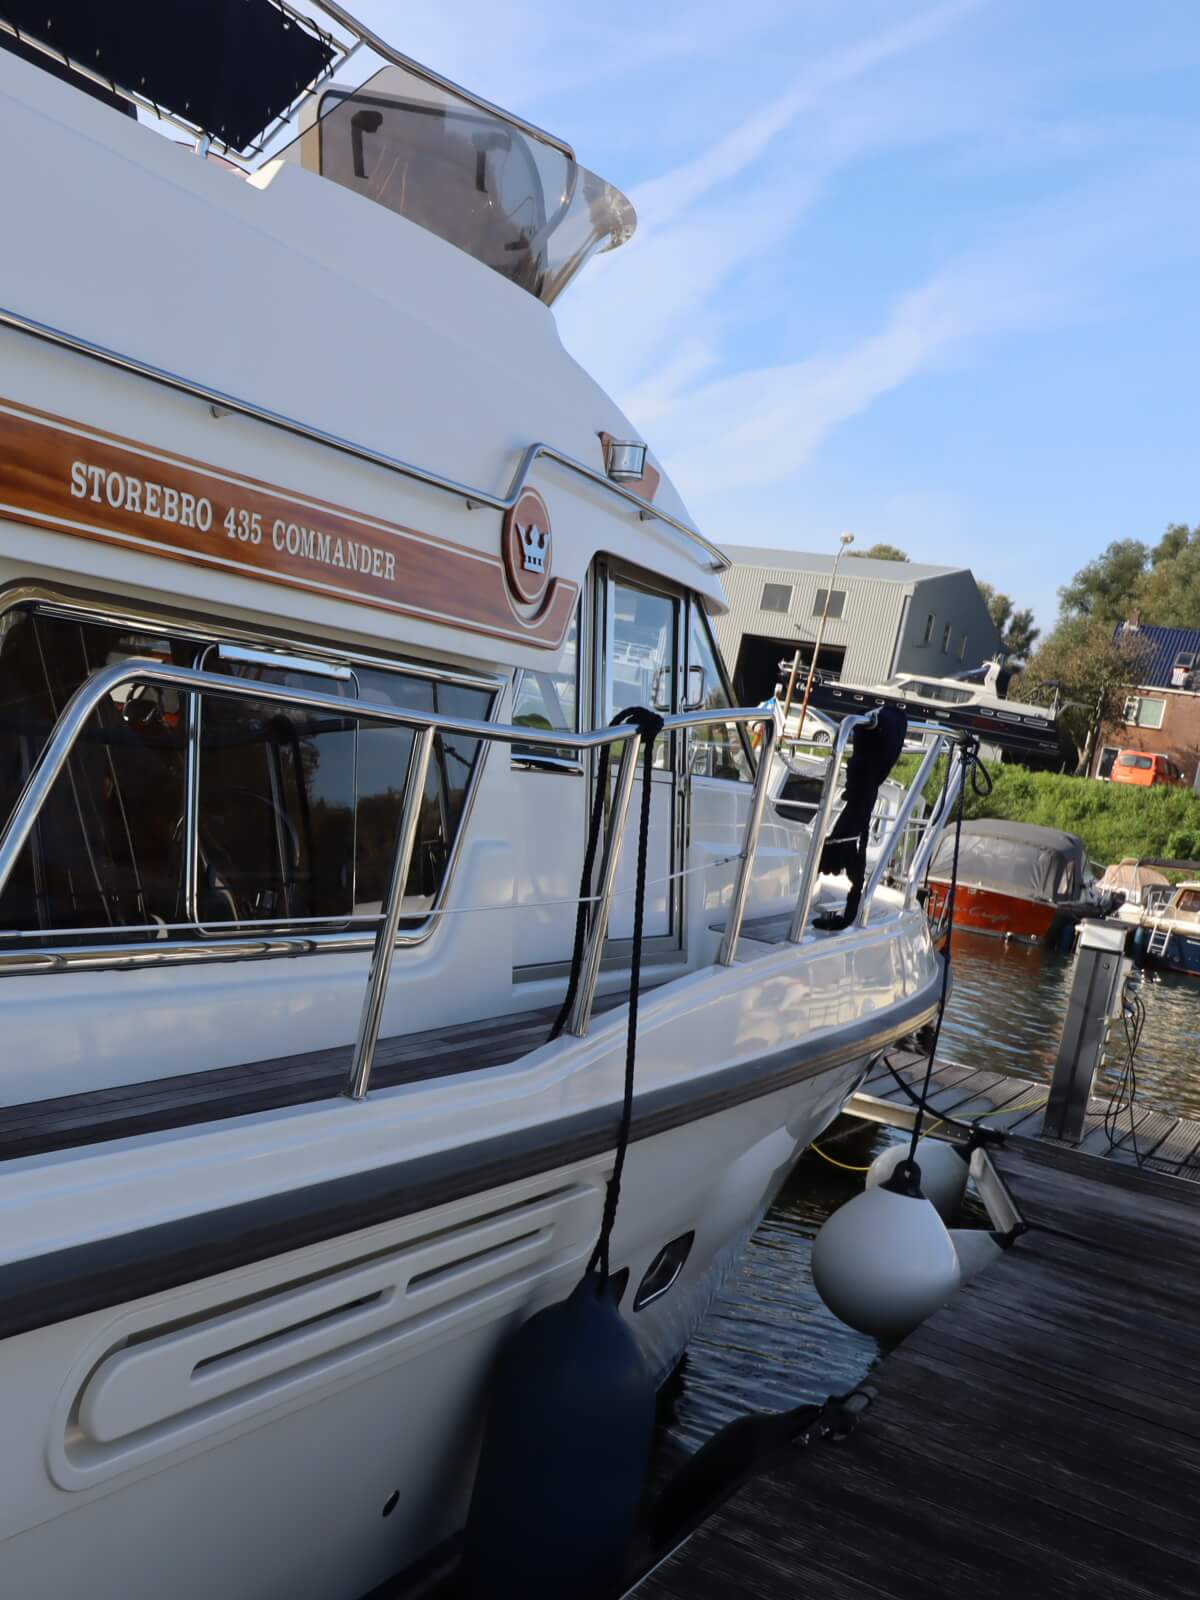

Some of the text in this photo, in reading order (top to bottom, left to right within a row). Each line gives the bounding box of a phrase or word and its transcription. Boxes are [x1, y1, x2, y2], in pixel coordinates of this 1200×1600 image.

[70, 461, 397, 581] STOREBRO 435 COMMANDER
